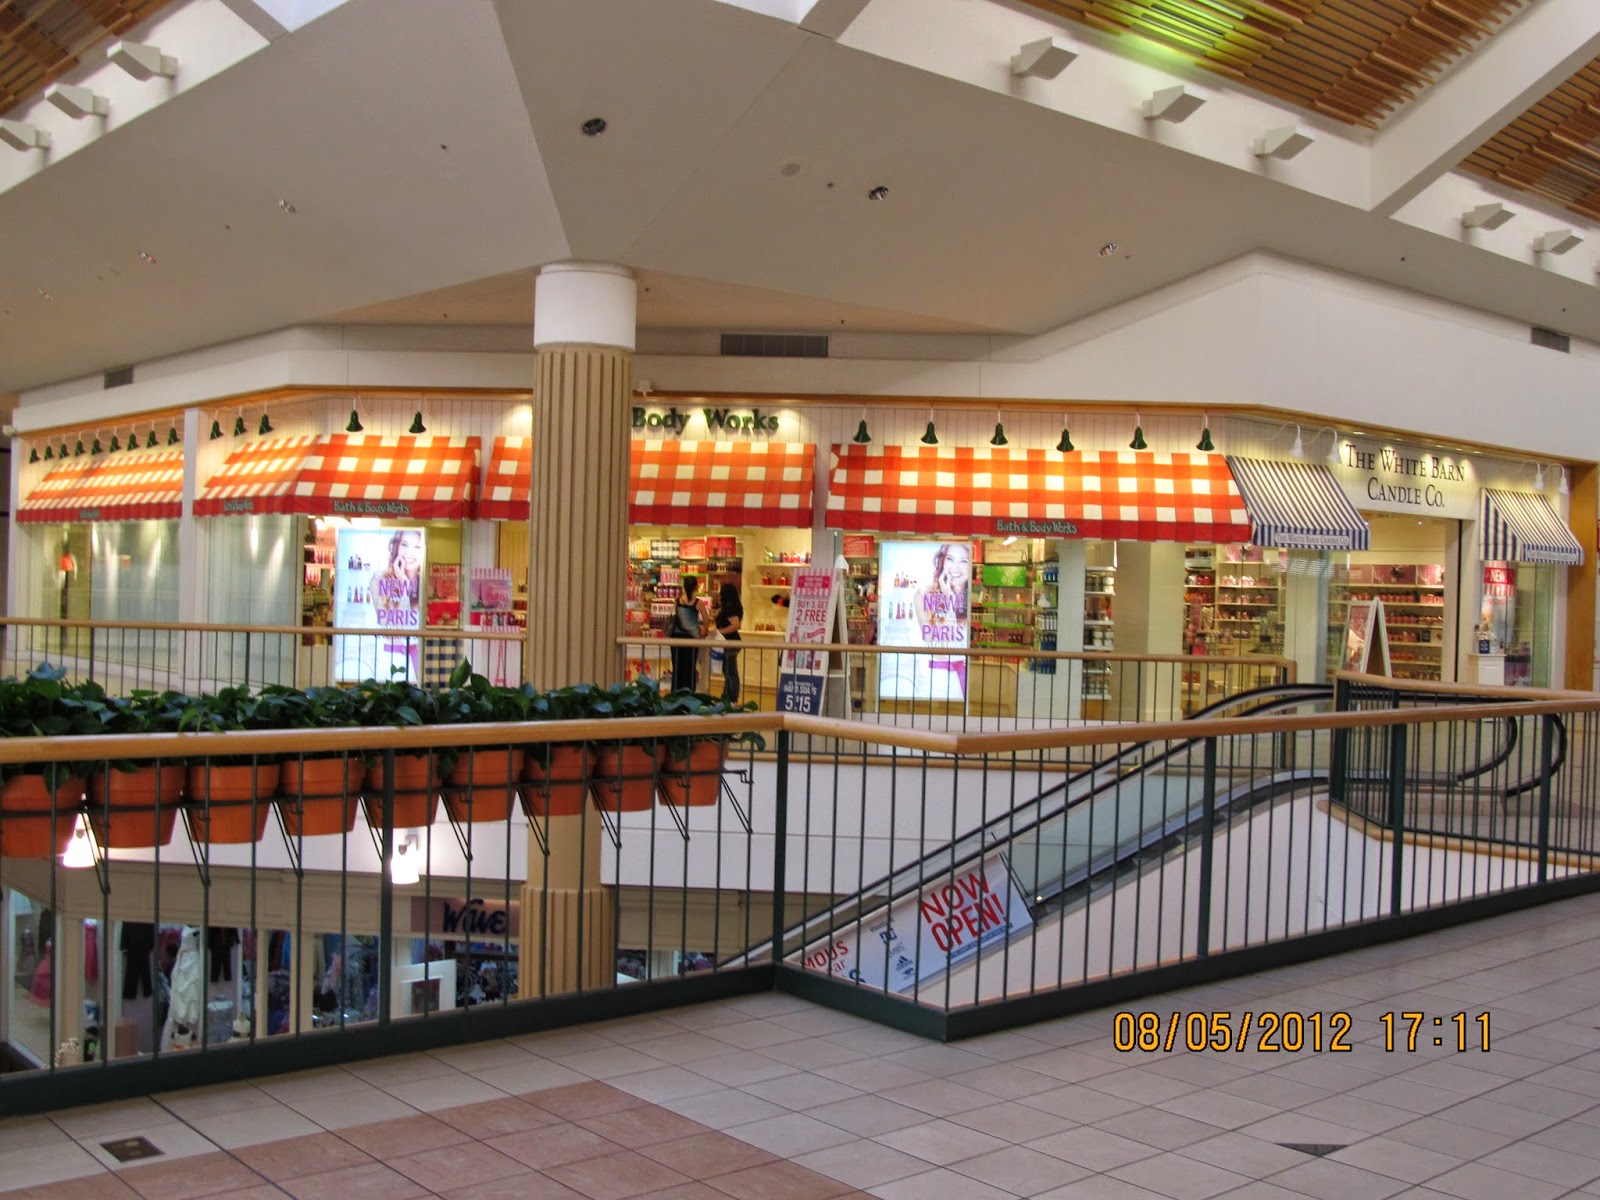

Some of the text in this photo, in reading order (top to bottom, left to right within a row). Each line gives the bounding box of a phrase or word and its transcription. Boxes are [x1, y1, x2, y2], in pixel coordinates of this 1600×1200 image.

[632, 407, 779, 435] Body Works
[1346, 444, 1465, 482] THE WHITE BARN
[1367, 477, 1421, 505] CANDLE
[334, 500, 410, 514] Bath & Body Works
[997, 519, 1078, 534] Bath & Body Works
[379, 578, 417, 598] NEW!
[798, 600, 811, 608] BUY
[817, 601, 829, 609] GET
[923, 592, 965, 613] NEW!
[377, 609, 418, 626] PARIS
[796, 609, 827, 622] 2 FREE
[922, 624, 965, 642] PARIS
[799, 685, 817, 696] SOAS
[785, 694, 794, 711] 5
[918, 868, 989, 924] NOW
[931, 893, 1008, 952] OPEN!
